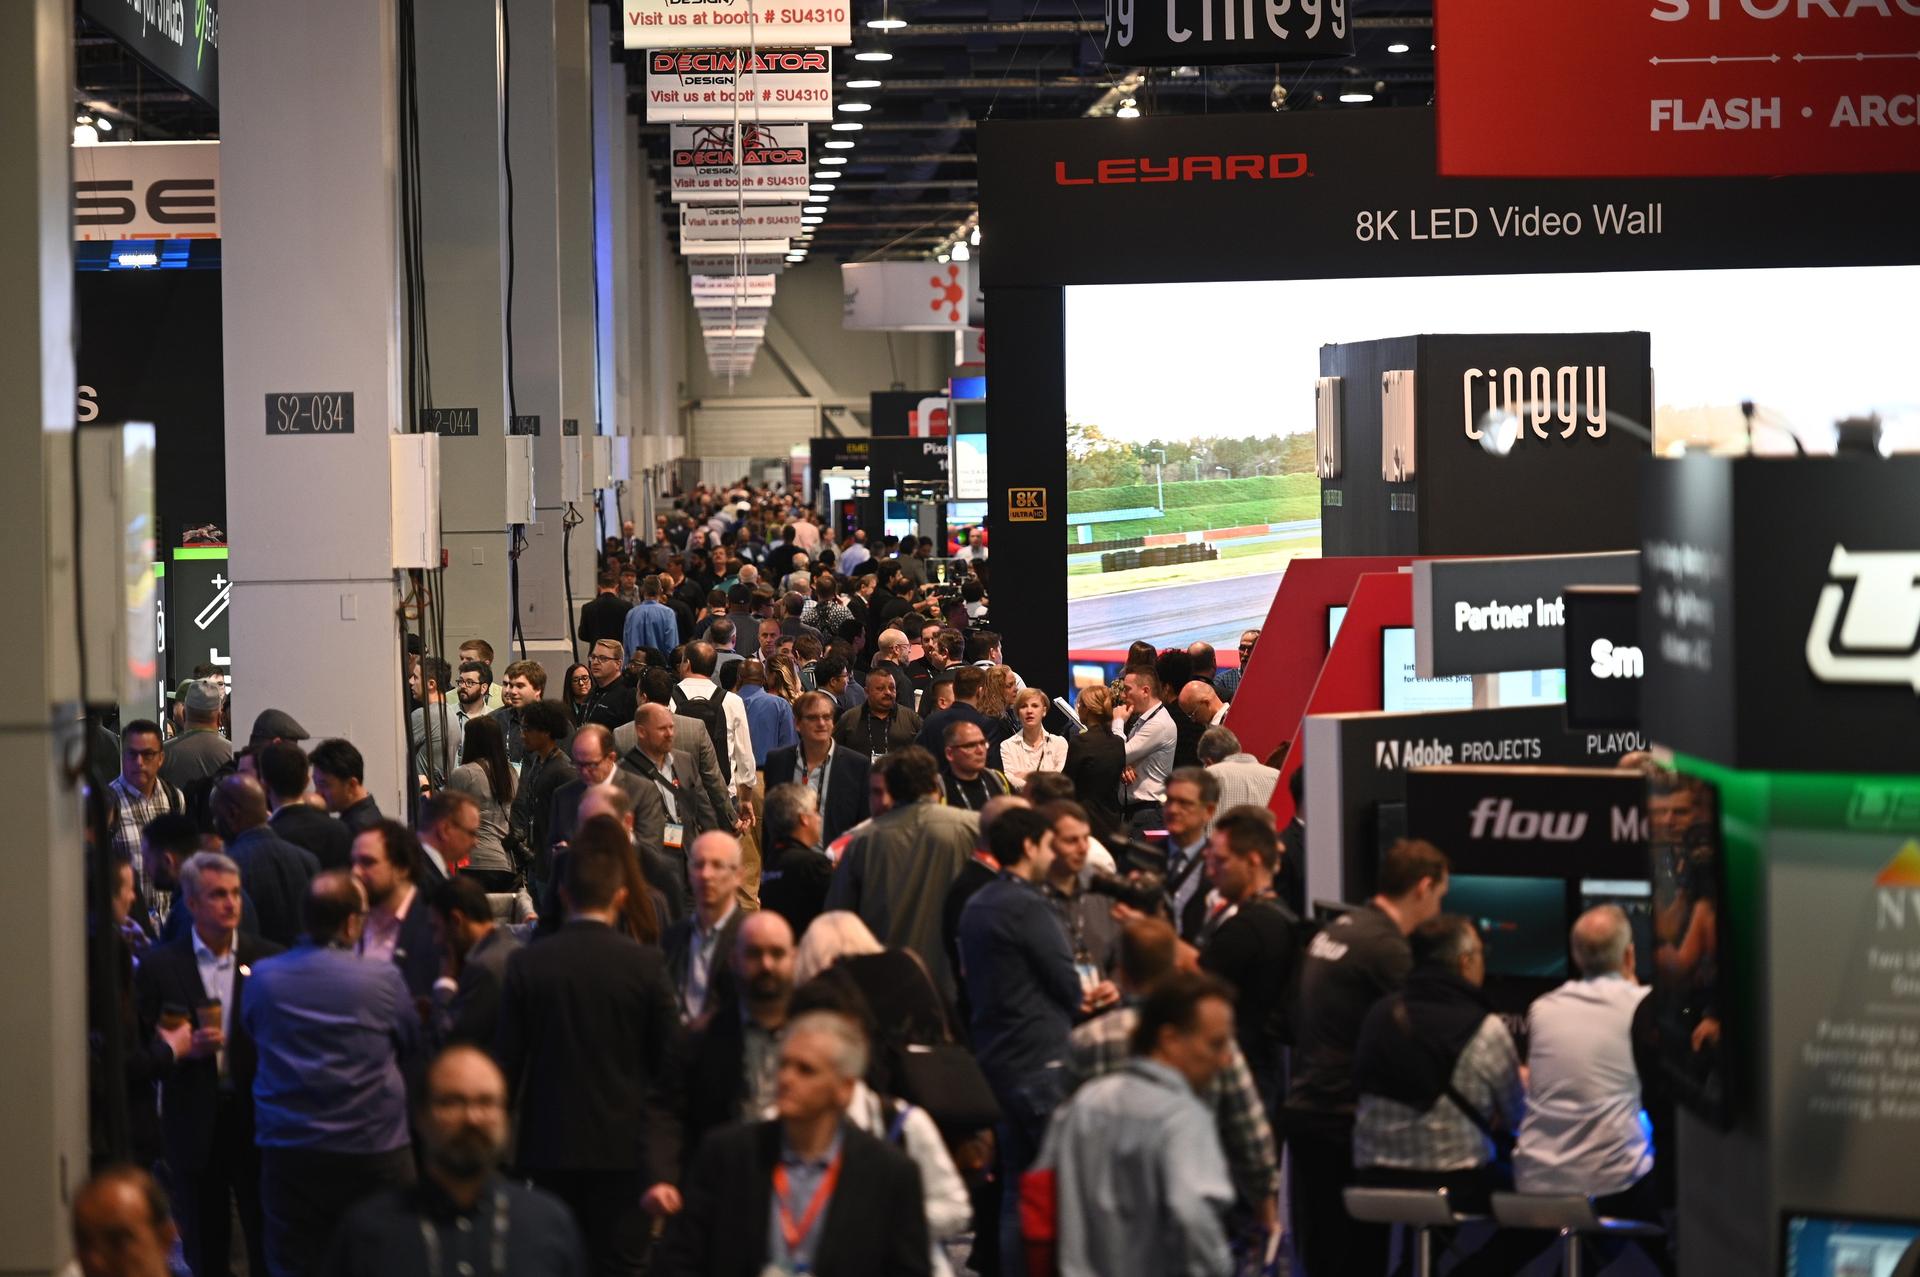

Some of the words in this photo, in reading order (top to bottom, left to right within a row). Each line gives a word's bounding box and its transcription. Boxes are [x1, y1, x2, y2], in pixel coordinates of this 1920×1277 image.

[629, 12, 663, 25] Visit
[668, 13, 687, 25] us
[692, 12, 708, 25] at
[713, 11, 758, 24] booth
[780, 9, 845, 24] SU4310
[684, 77, 734, 85] DESIGN
[651, 92, 679, 103] Visit
[684, 92, 699, 102] us
[703, 91, 716, 102] at
[776, 90, 828, 101] SU4310
[1650, 97, 1781, 132] FLASH
[1829, 94, 1920, 128] ARC
[675, 178, 695, 188] Visit
[698, 178, 710, 188] us
[713, 178, 722, 187] at
[767, 175, 806, 186] SU4310
[1355, 209, 1400, 242] 8K
[1410, 208, 1479, 241] LED
[1488, 205, 1583, 238] Video
[1593, 202, 1663, 235] Wall
[277, 395, 344, 431] S2-034
[428, 410, 471, 434] 2-044
[1016, 491, 1039, 507] 8K
[1455, 600, 1533, 632] Partner
[1403, 738, 1453, 768] Adobe
[1461, 738, 1542, 763] PROJECTS
[1586, 731, 1652, 755] PLAYOU
[1469, 798, 1588, 840] flow
